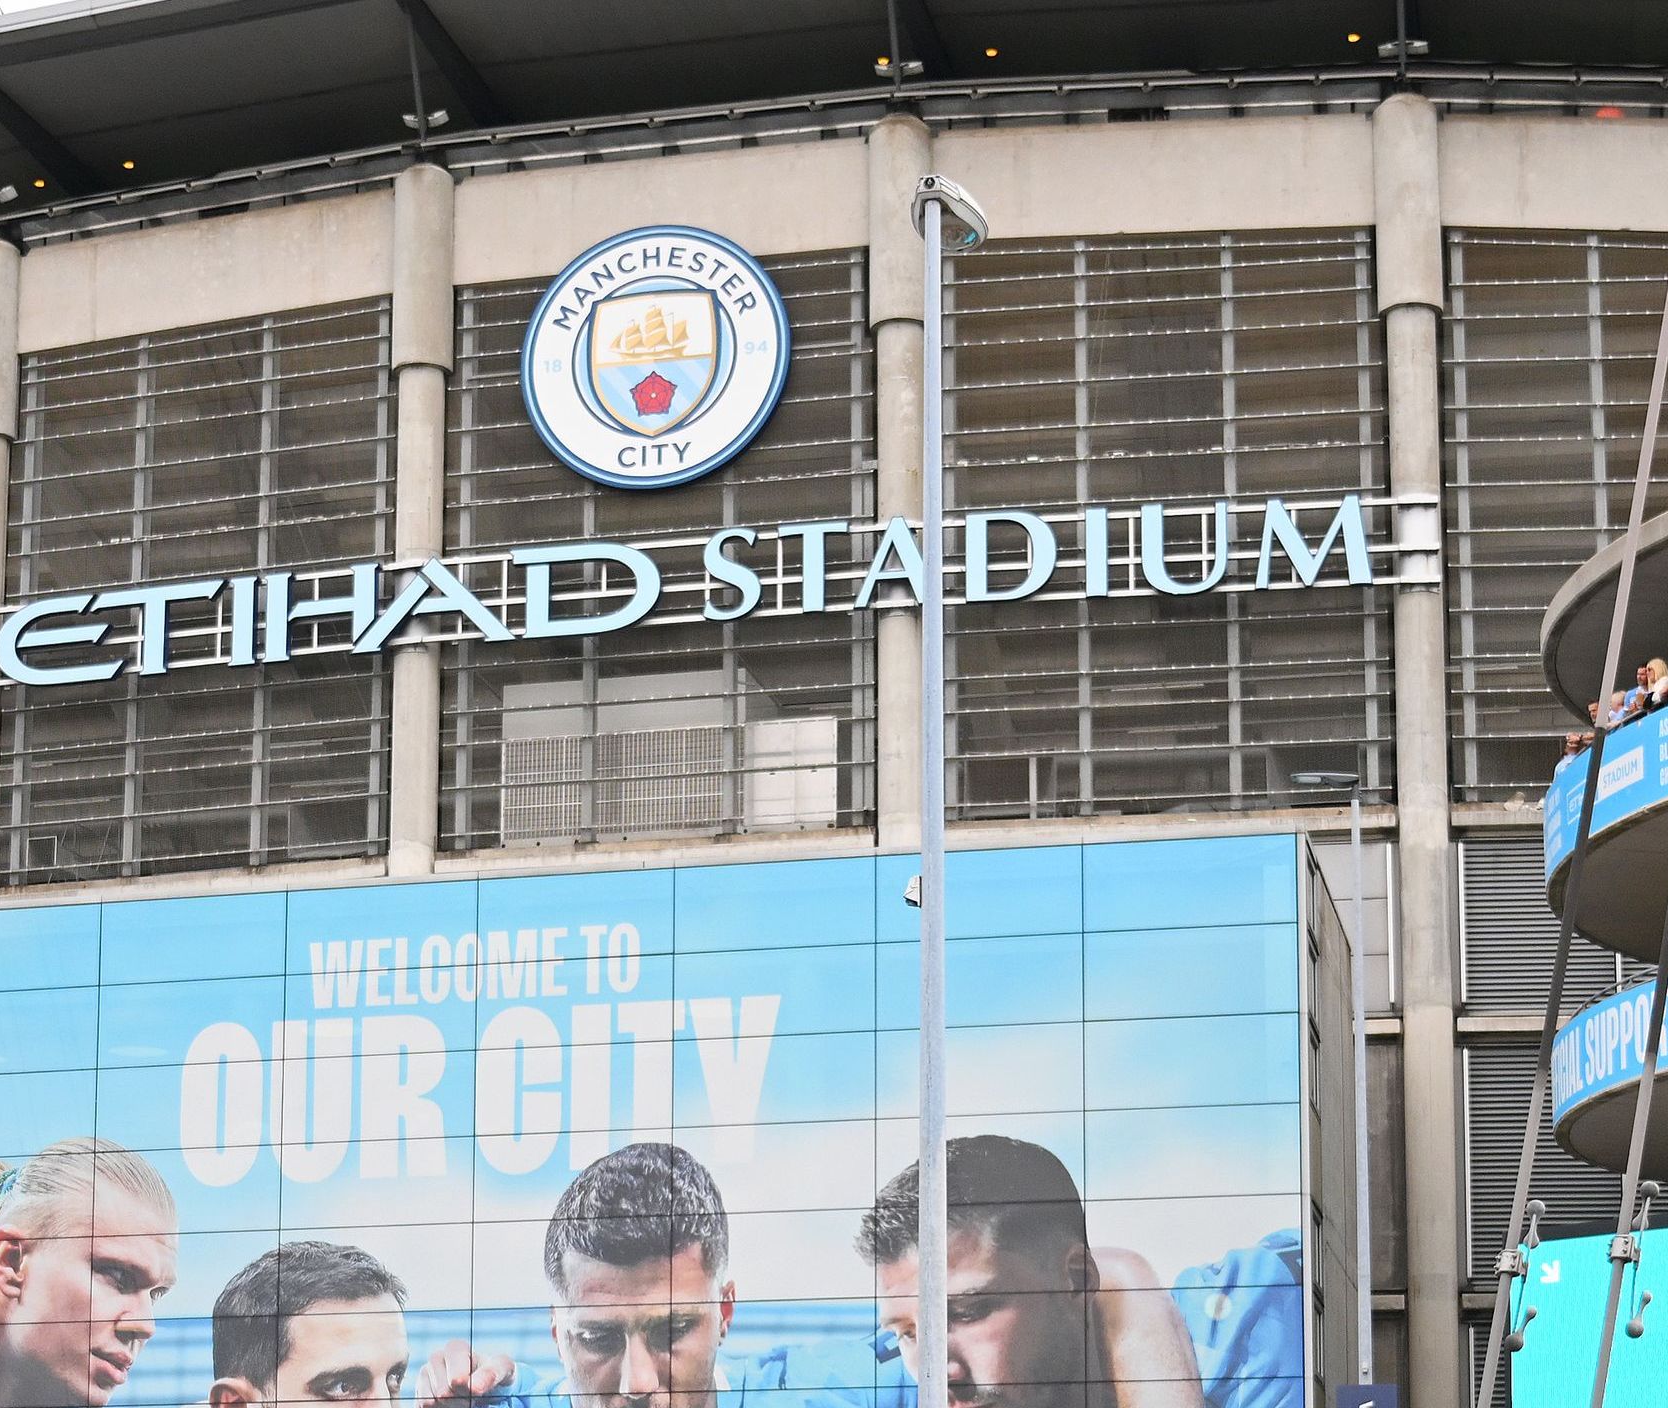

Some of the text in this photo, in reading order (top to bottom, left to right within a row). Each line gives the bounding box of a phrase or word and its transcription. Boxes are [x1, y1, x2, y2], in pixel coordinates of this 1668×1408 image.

[553, 246, 757, 331] MANCHESTER
[543, 360, 562, 373] 18
[744, 342, 769, 357] 94
[618, 442, 692, 468] CITY
[703, 493, 1376, 622] STADIUM
[309, 923, 641, 1010] WELCOME TO
[180, 995, 782, 1188] OUR CITY
